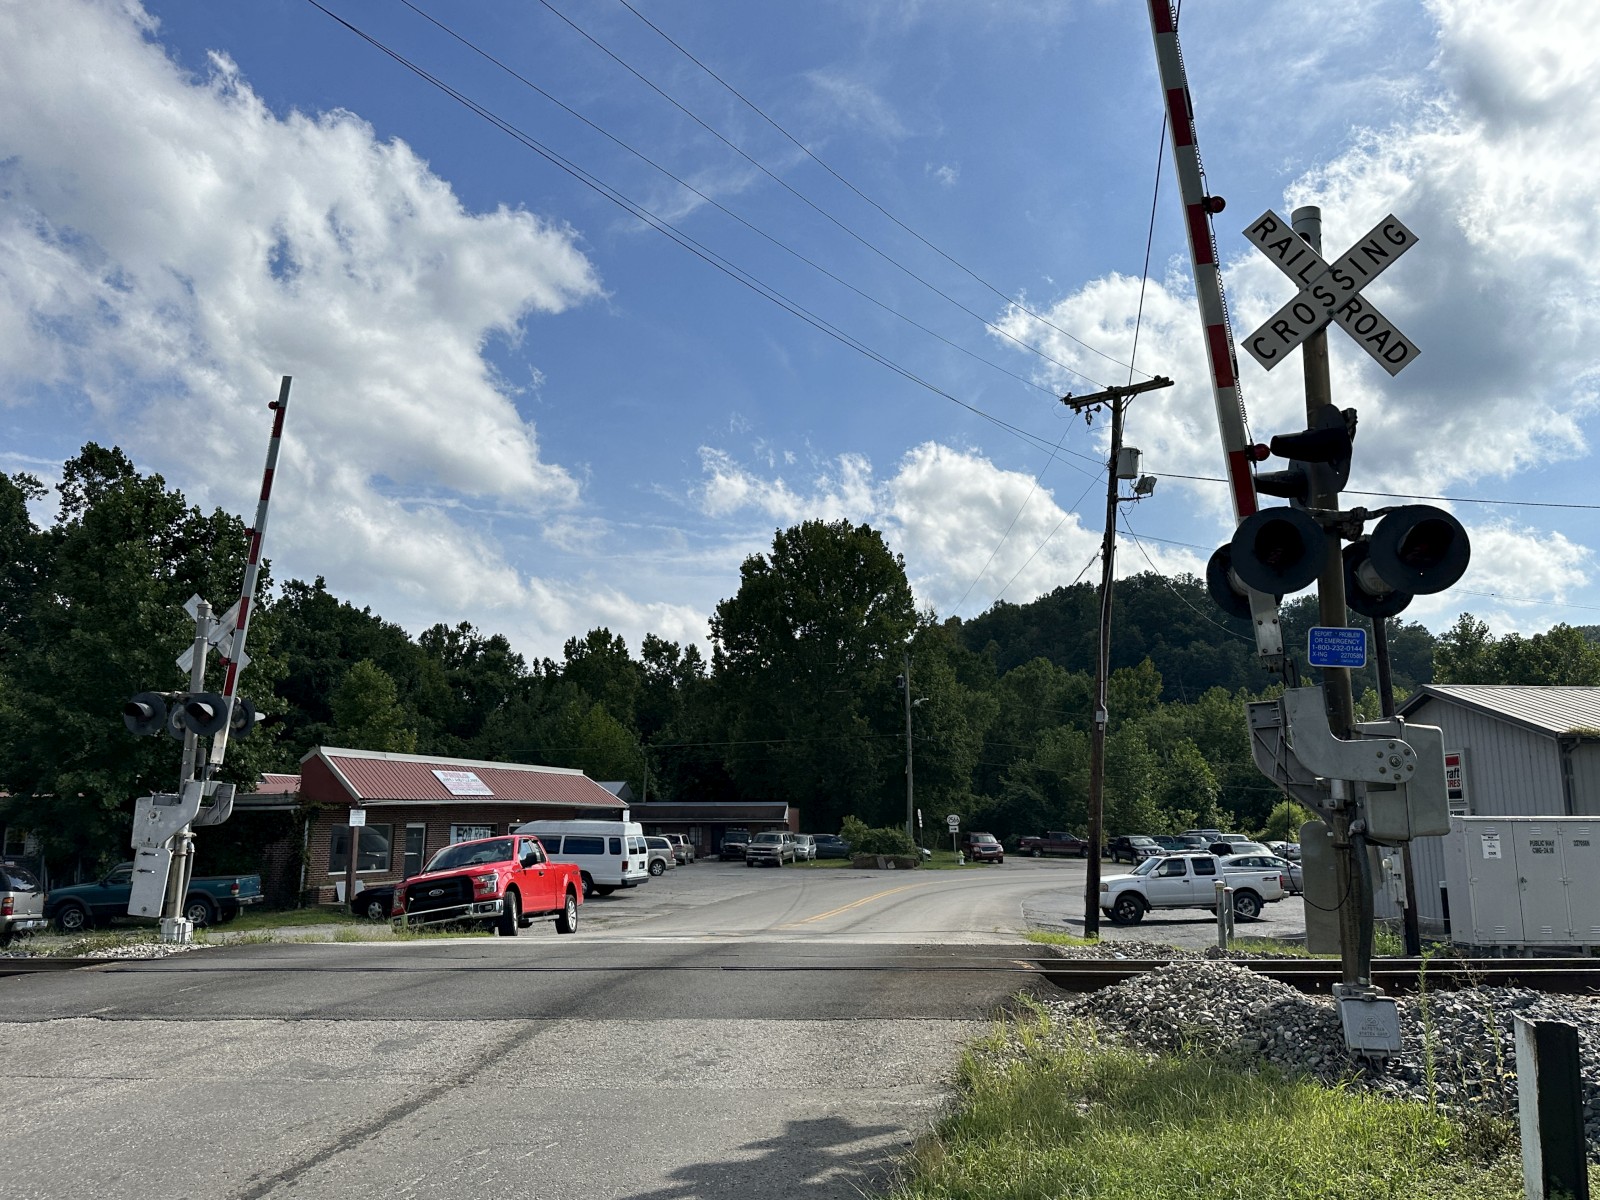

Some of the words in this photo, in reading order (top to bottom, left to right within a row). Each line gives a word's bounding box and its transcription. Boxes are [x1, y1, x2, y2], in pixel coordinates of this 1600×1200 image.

[1252, 216, 1316, 284] RAIL
[1338, 298, 1408, 363] ROAD
[1253, 224, 1407, 360] CROSSING
[457, 827, 472, 842] FOR
